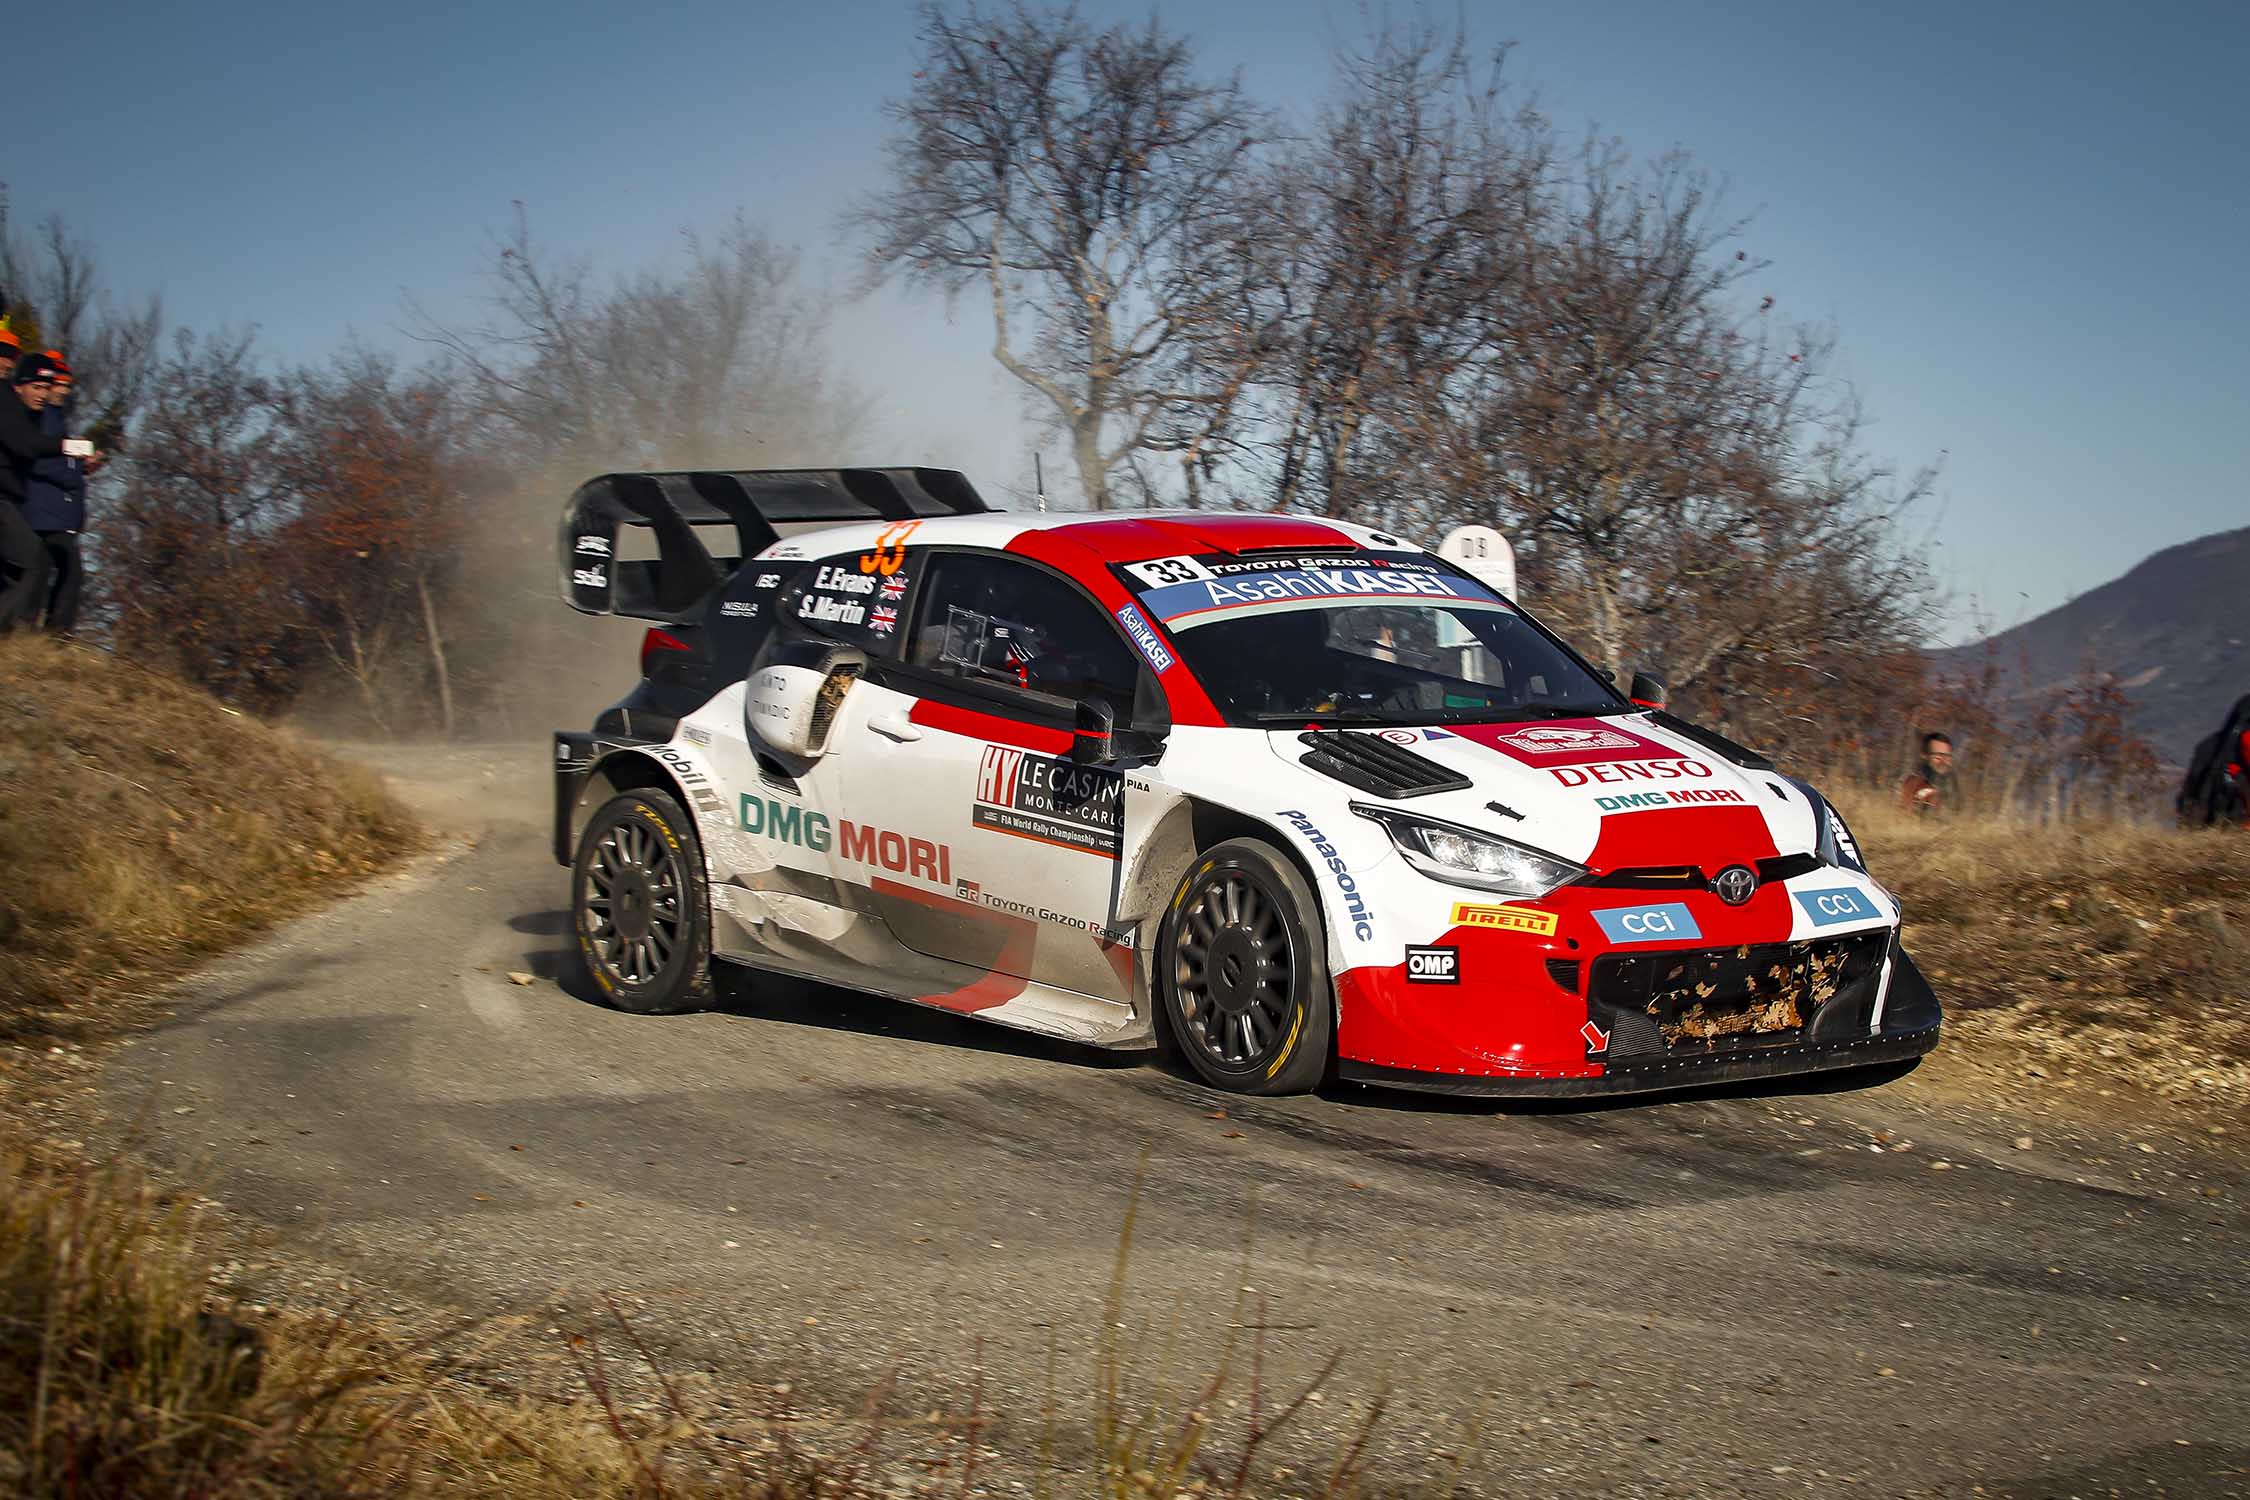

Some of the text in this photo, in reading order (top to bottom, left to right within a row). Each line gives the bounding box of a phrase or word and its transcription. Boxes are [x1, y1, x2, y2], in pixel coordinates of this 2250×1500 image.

[814, 566, 877, 595] E.Evans
[1144, 560, 1199, 583] 33
[1207, 557, 1439, 575] TOYOTA GAZOO Racing
[798, 594, 865, 625] S.Martin
[642, 745, 707, 784] Mobil
[1550, 760, 1713, 787] DENSO
[1021, 760, 1125, 805] LE CASIN
[1127, 779, 1150, 792] PIAA
[1593, 789, 1745, 810] DMG MORI
[739, 792, 832, 853] DMG
[839, 818, 951, 885] MORI
[1001, 815, 1012, 826] FIA
[1013, 818, 1031, 830] World
[1033, 821, 1049, 836] Rally
[1050, 826, 1095, 846] Championship
[1276, 810, 1374, 942] Panasonic
[957, 886, 1130, 946] GR TOYOTA GAZOO Racing
[1457, 906, 1550, 931] PIRELLI
[1409, 955, 1455, 974] OMP
